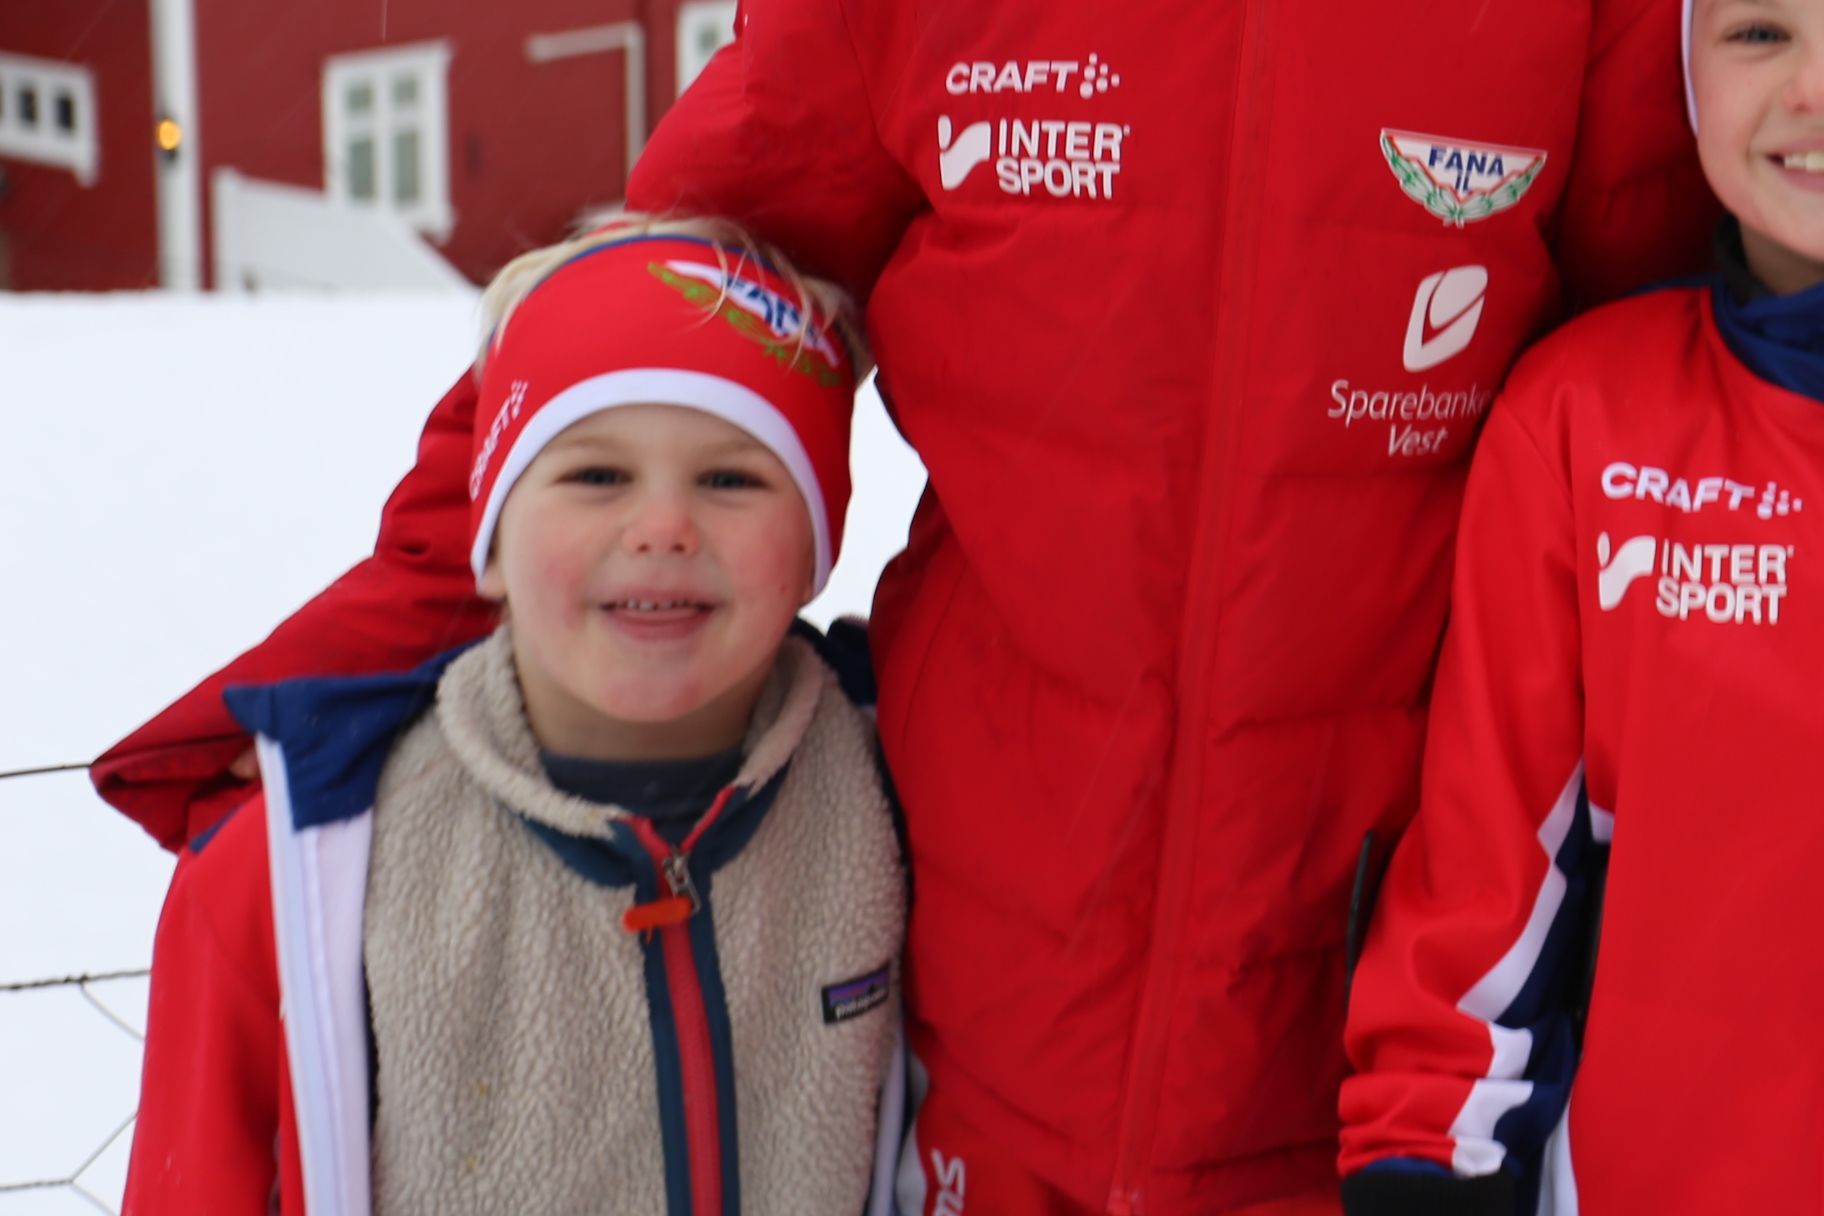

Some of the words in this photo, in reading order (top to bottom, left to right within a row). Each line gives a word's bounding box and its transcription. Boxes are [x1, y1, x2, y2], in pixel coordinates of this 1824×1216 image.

[946, 60, 1079, 96] CRAFT
[998, 117, 1123, 162] INTER
[1428, 144, 1505, 177] FANA
[996, 156, 1121, 200] SPORT
[1389, 423, 1449, 458] Vest
[1601, 461, 1756, 514] CRAFT
[1662, 538, 1788, 586] INTER
[1656, 575, 1788, 626] SPORT
